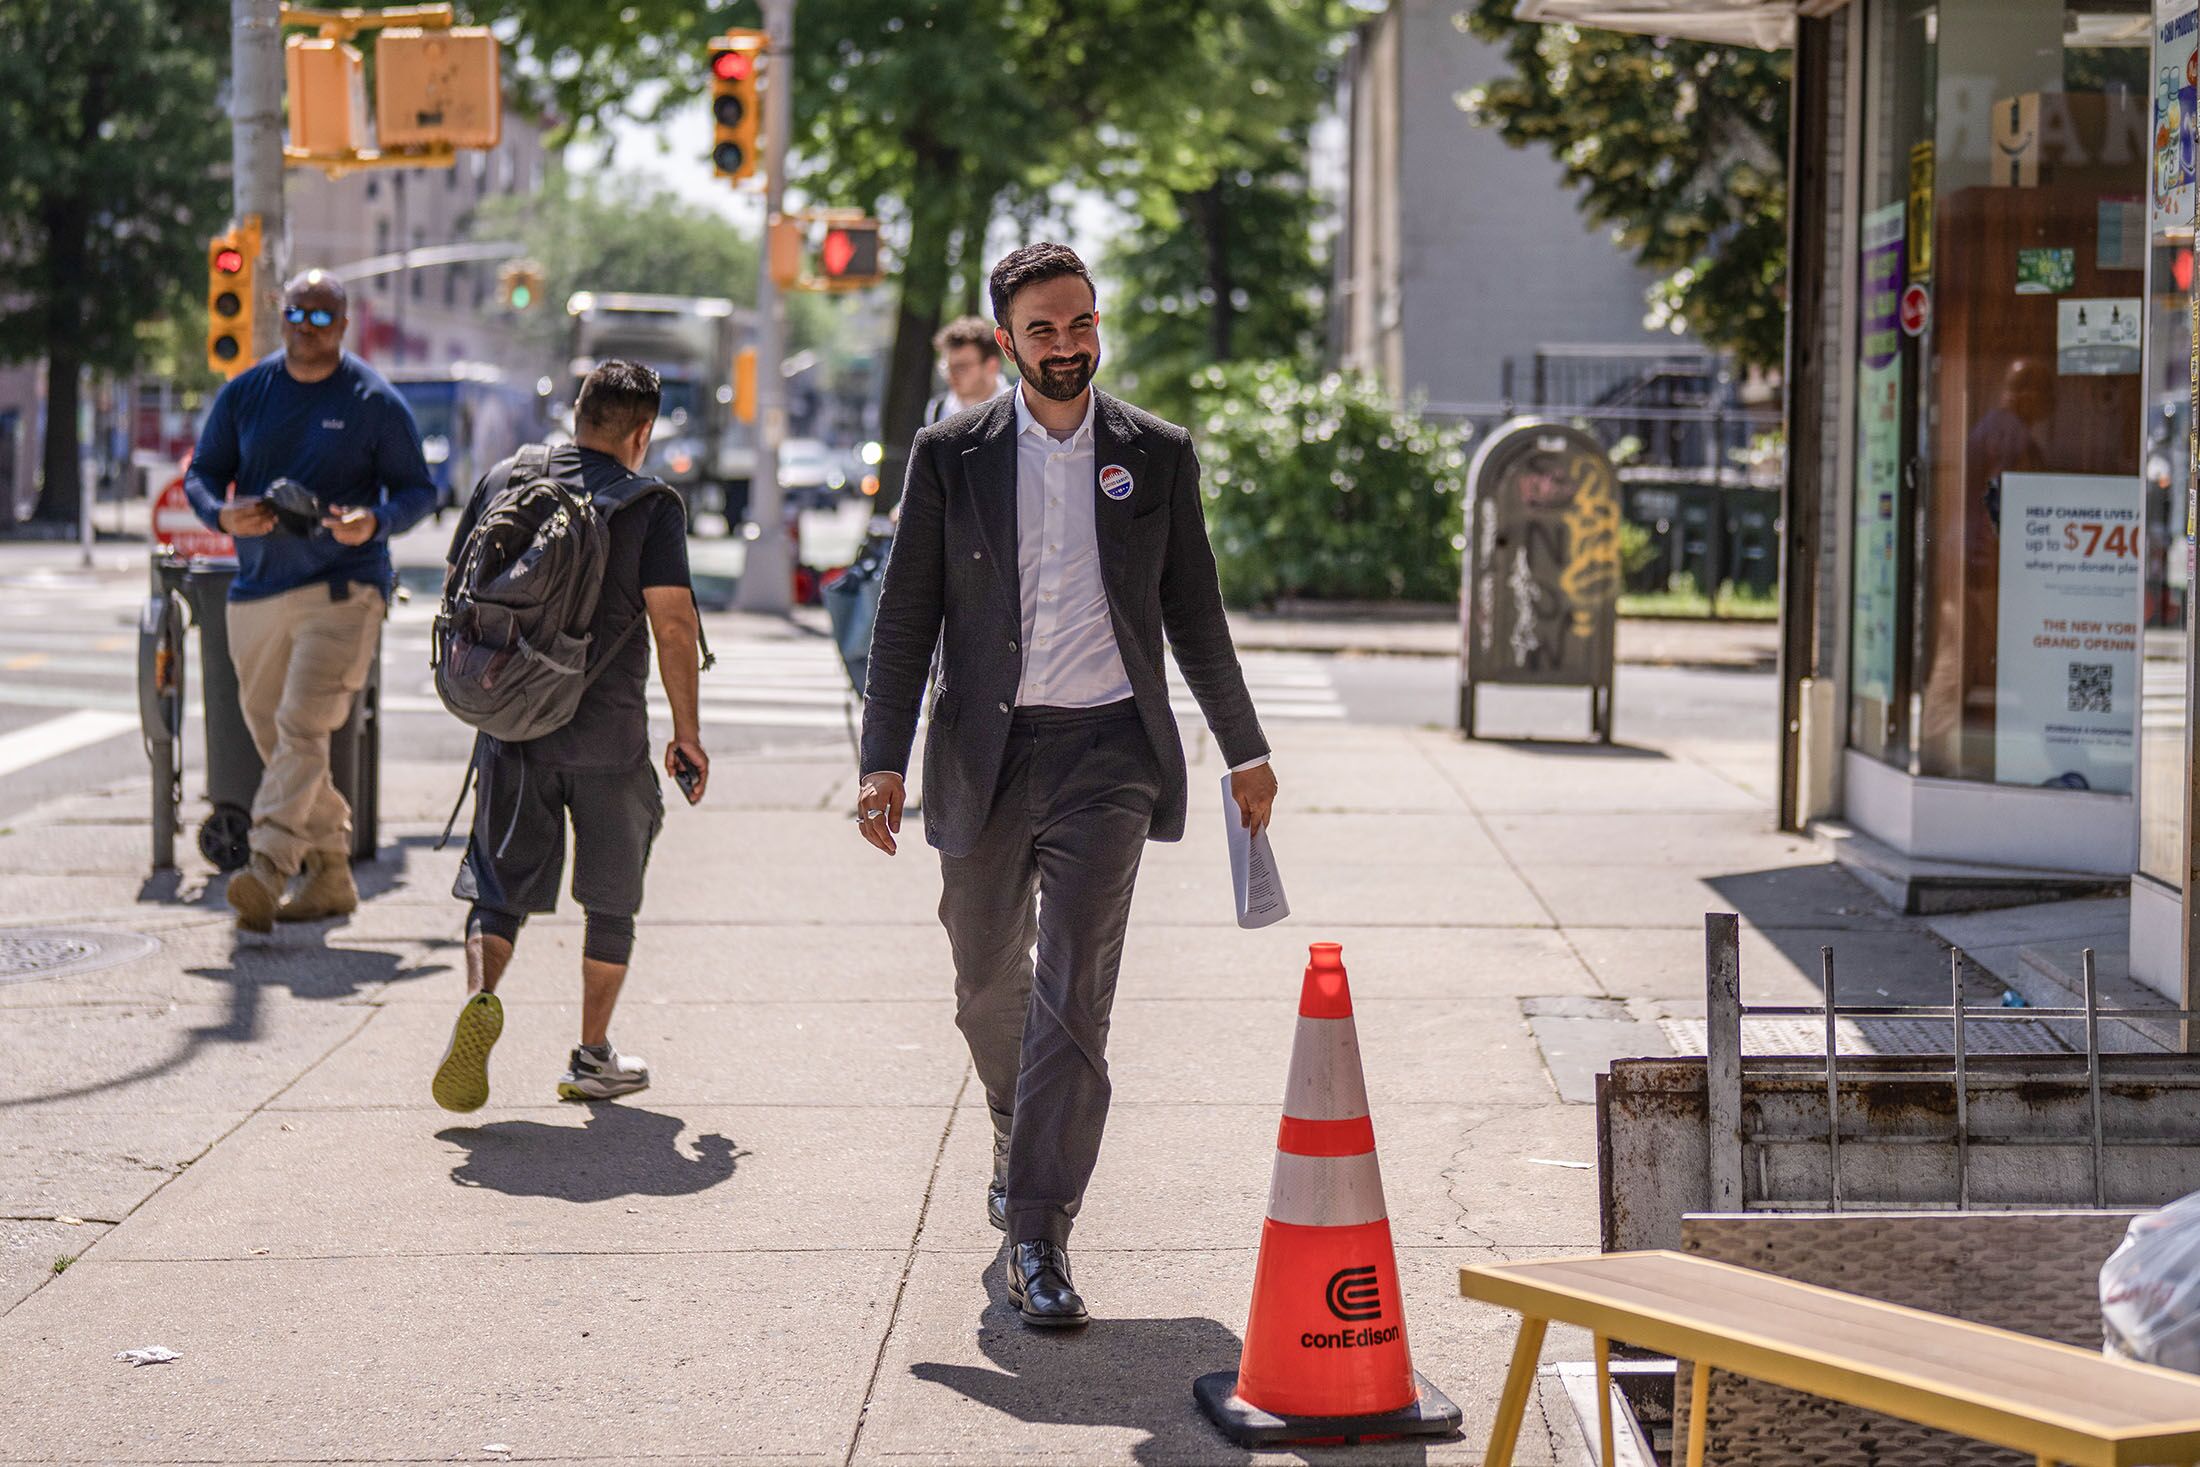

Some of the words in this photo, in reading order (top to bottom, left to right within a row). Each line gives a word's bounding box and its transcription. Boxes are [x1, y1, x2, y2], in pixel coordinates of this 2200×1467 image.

[2025, 506, 2053, 518] HELP
[2056, 507, 2102, 519] CHANGE
[2104, 509, 2133, 521] LIVES
[2025, 521, 2050, 535] Get
[2025, 540, 2043, 554] up
[2046, 540, 2060, 551] to
[2025, 560, 2053, 570] when
[2057, 564, 2076, 574] you
[2079, 561, 2115, 573] donate
[2043, 619, 2067, 632] THE
[2072, 621, 2102, 634] NEW
[2033, 635, 2080, 649] GRAND
[1301, 1325, 1399, 1348] conEdison
